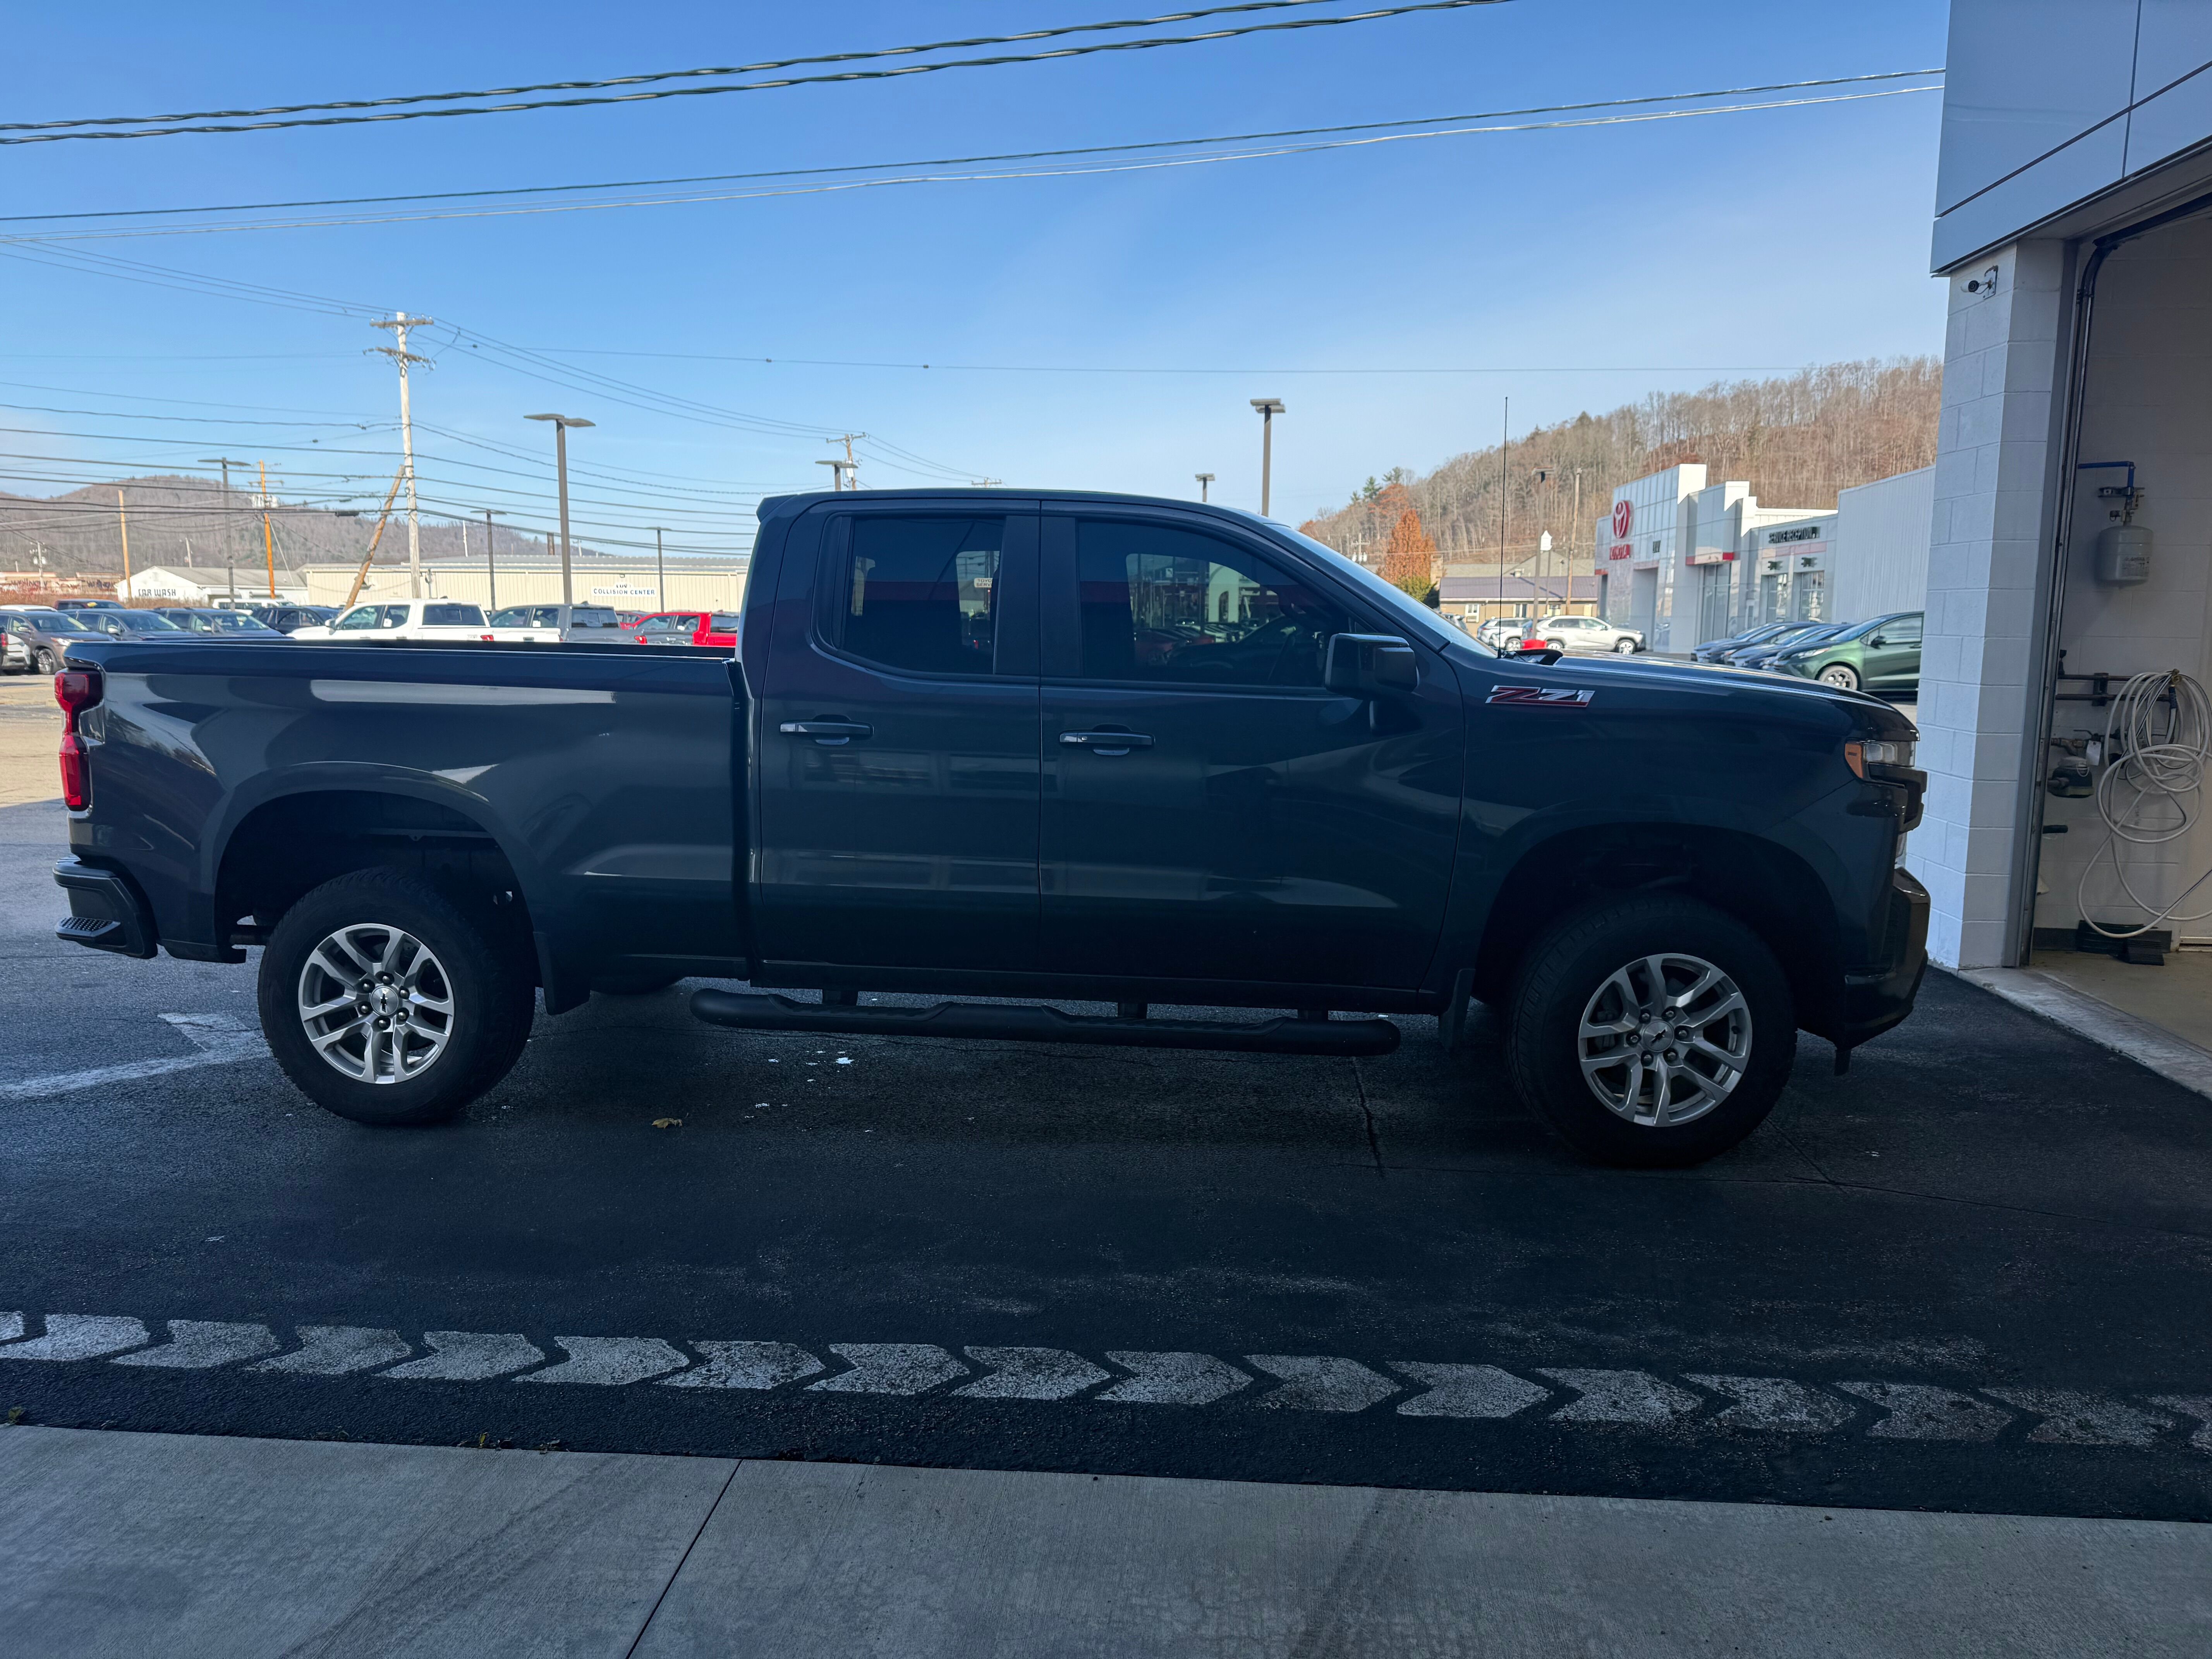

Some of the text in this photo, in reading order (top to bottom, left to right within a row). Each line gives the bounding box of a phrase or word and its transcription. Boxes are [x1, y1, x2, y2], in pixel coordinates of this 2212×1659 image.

[1769, 527, 1813, 543] SERVICE RECEPTION
[1609, 544, 1629, 560] TOYOTA
[154, 589, 176, 597] WASH
[1485, 685, 1595, 708] Z71
